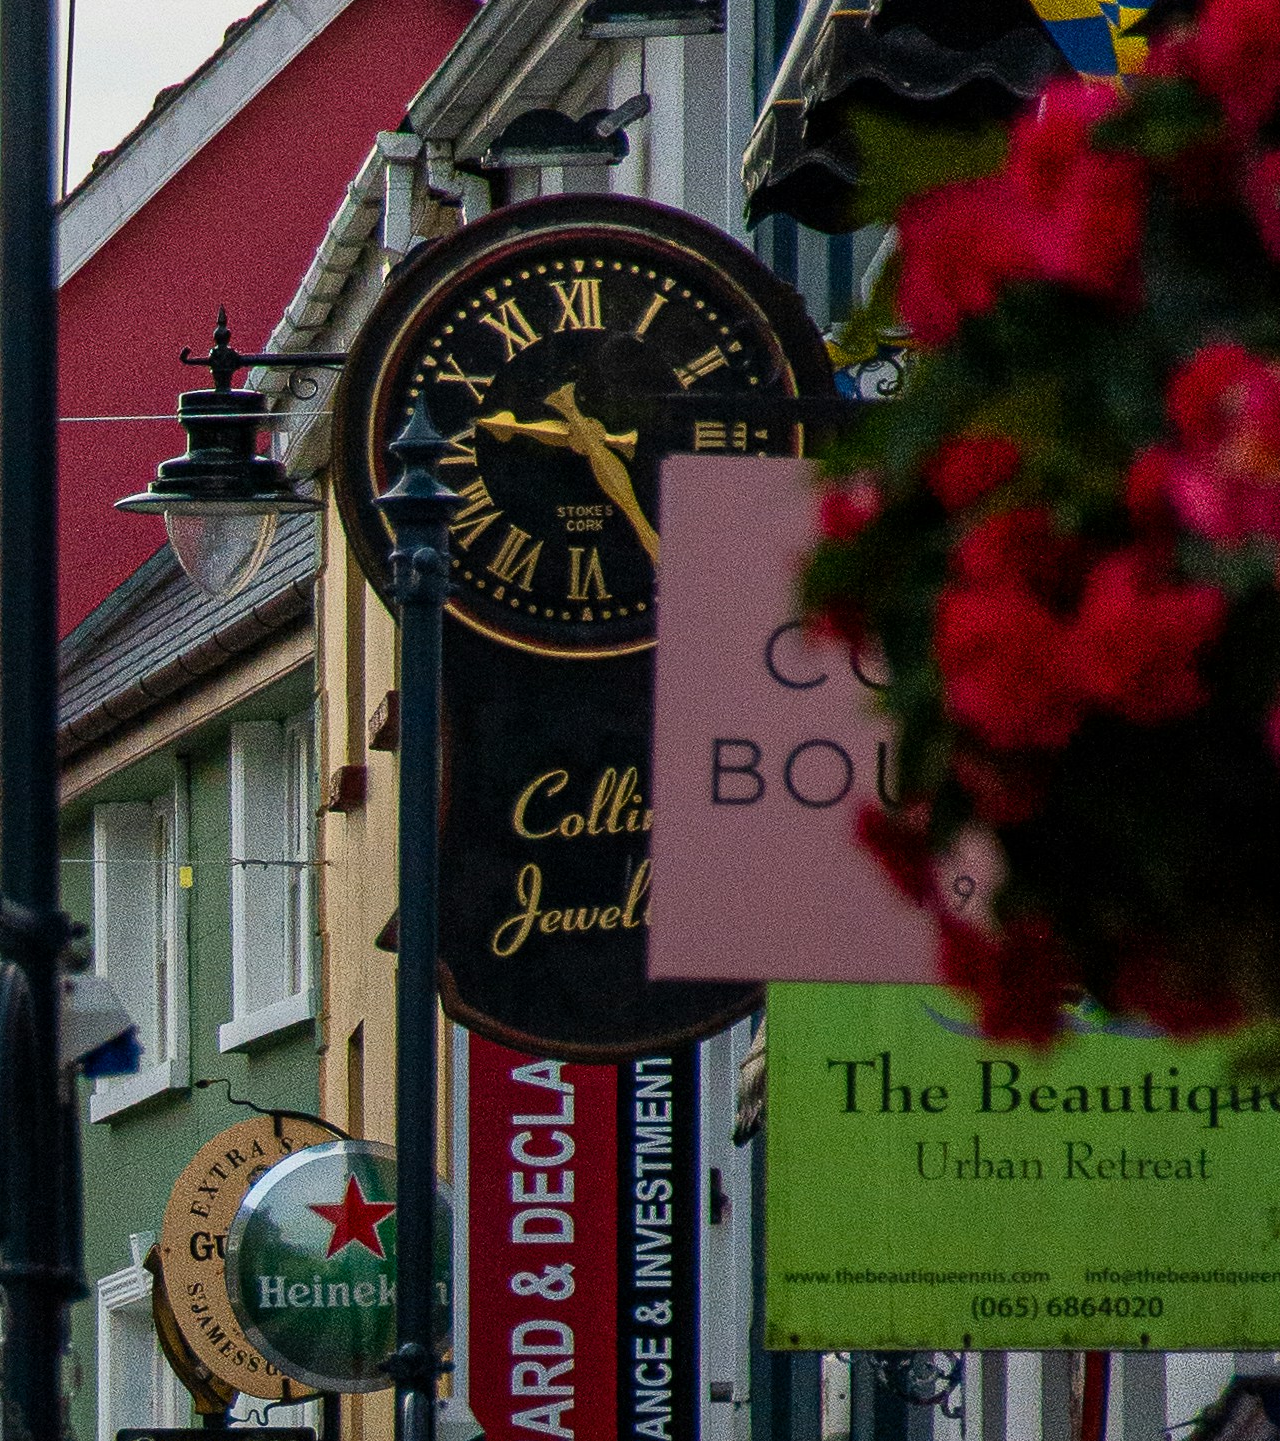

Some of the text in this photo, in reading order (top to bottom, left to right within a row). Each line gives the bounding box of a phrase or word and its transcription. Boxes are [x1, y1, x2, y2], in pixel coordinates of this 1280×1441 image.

[479, 297, 544, 363] XI
[549, 278, 607, 334] XII
[672, 344, 731, 391] II
[556, 504, 615, 519] STOKES
[565, 519, 605, 533] CORK
[567, 547, 613, 601] VI
[492, 852, 654, 957] Jewel
[827, 1051, 949, 1115] The
[510, 1058, 577, 1245] DECLA
[914, 1133, 1213, 1182] Urban Retreat
[189, 1137, 266, 1220] EXTRA
[258, 1274, 449, 1309] Heinekn
[510, 1262, 577, 1302] &
[634, 1298, 674, 1326] &
[971, 1296, 1164, 1321] (065) 6864020
